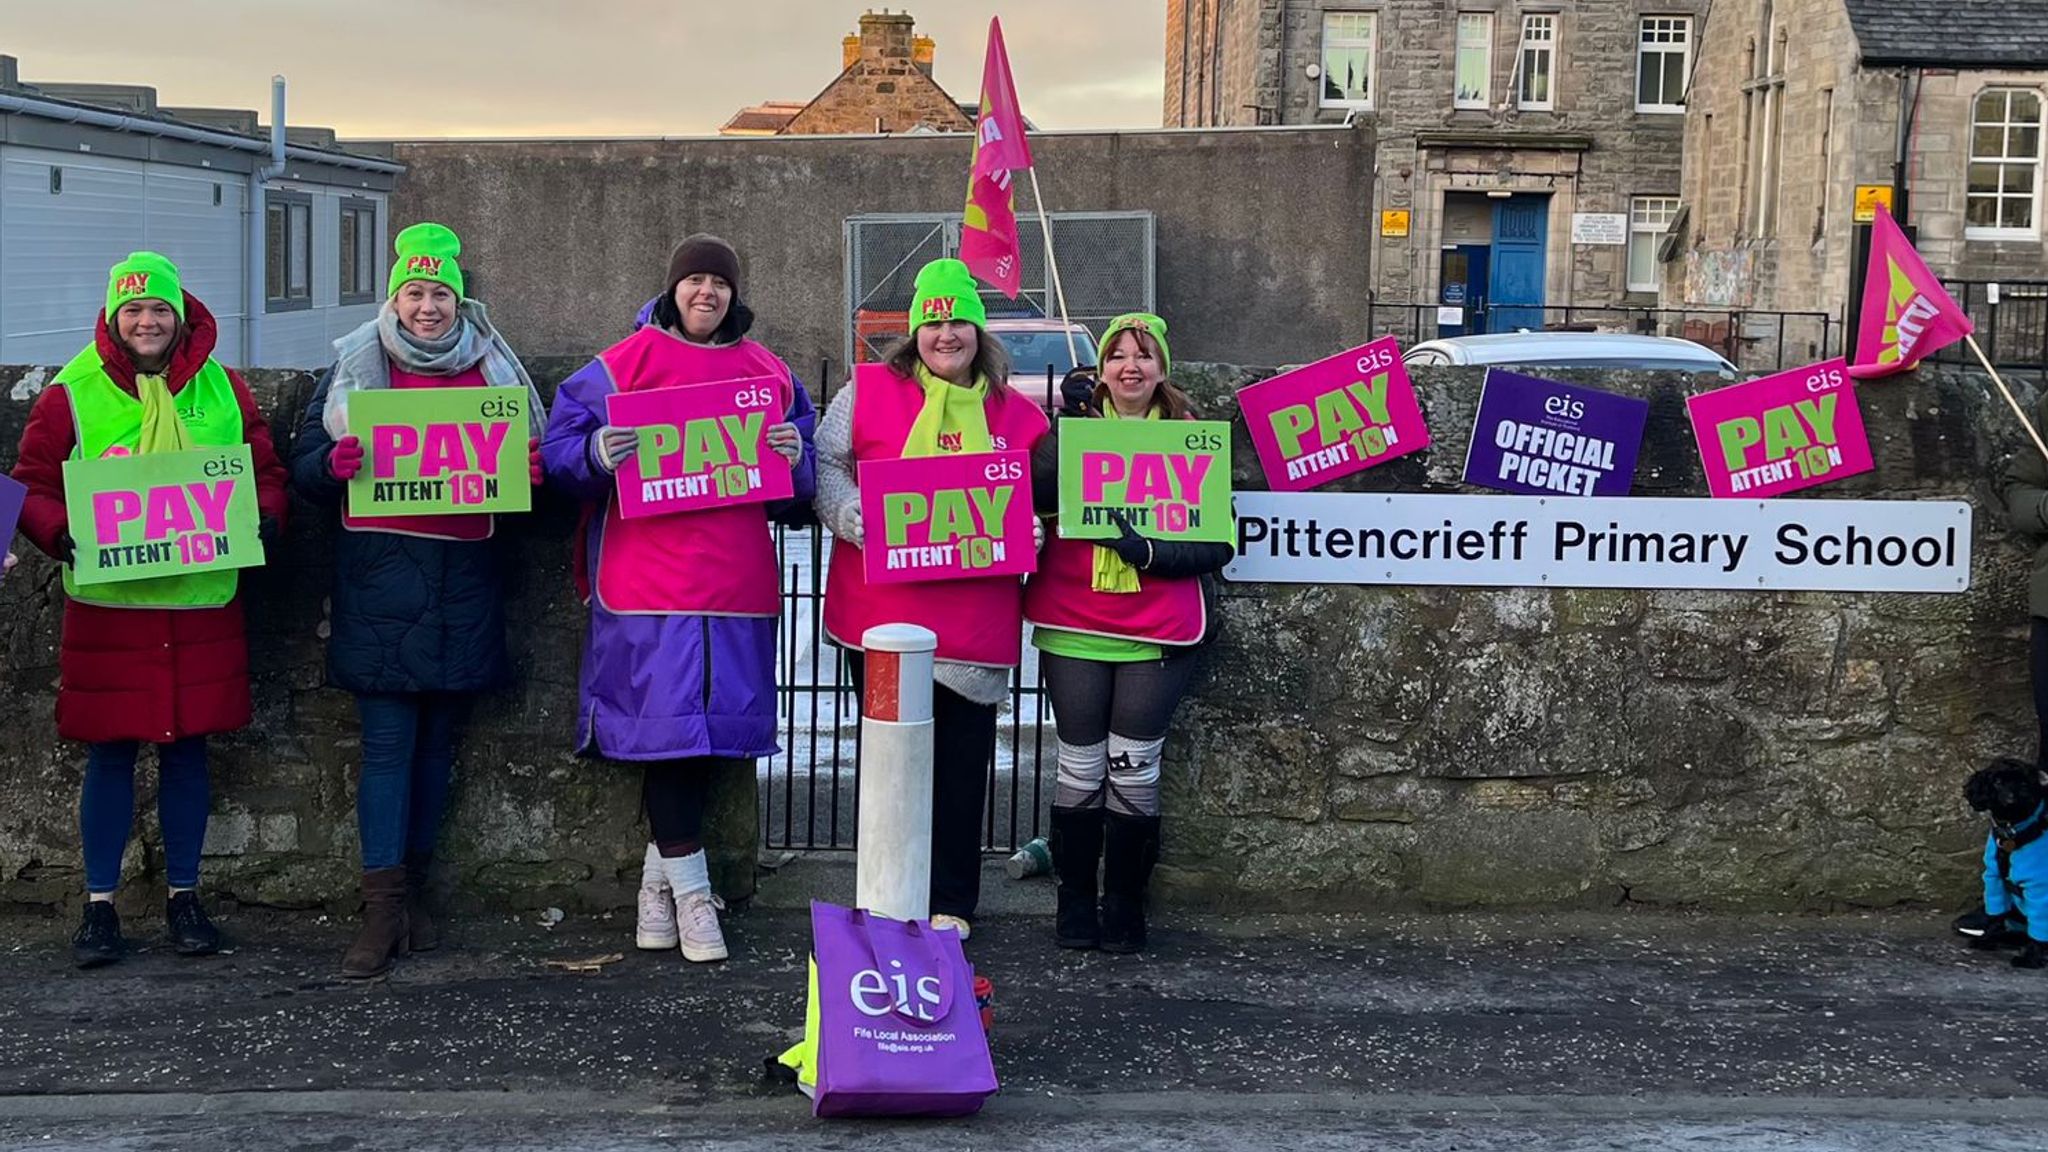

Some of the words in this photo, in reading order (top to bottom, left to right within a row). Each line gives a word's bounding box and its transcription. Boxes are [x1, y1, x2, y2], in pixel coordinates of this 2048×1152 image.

[407, 255, 443, 269] PAY
[116, 272, 150, 292] PAY
[922, 296, 956, 314] PAY
[1356, 348, 1393, 374] eis
[1806, 369, 1843, 392] eis
[480, 395, 519, 418] eis
[734, 385, 773, 408] eis
[1544, 393, 1585, 419] eis
[1267, 371, 1391, 460] PAY
[634, 411, 766, 479] PAY
[1184, 429, 1223, 450] eis
[1495, 419, 1615, 470] OFFICIAL
[1715, 392, 1838, 472] PAY
[372, 421, 511, 479] PAY
[203, 455, 244, 477] eis
[984, 458, 1023, 481] eis
[1082, 451, 1214, 505] PAY
[1498, 451, 1601, 496] PICKET
[92, 479, 236, 545] PAY
[883, 485, 1014, 546] PAY
[1237, 516, 1528, 561] Pittencrieff
[1555, 520, 1749, 572] Primary
[1775, 523, 1955, 567] School
[850, 959, 940, 1020] eis
[873, 1029, 899, 1041] Local
[900, 1031, 956, 1042] Association
